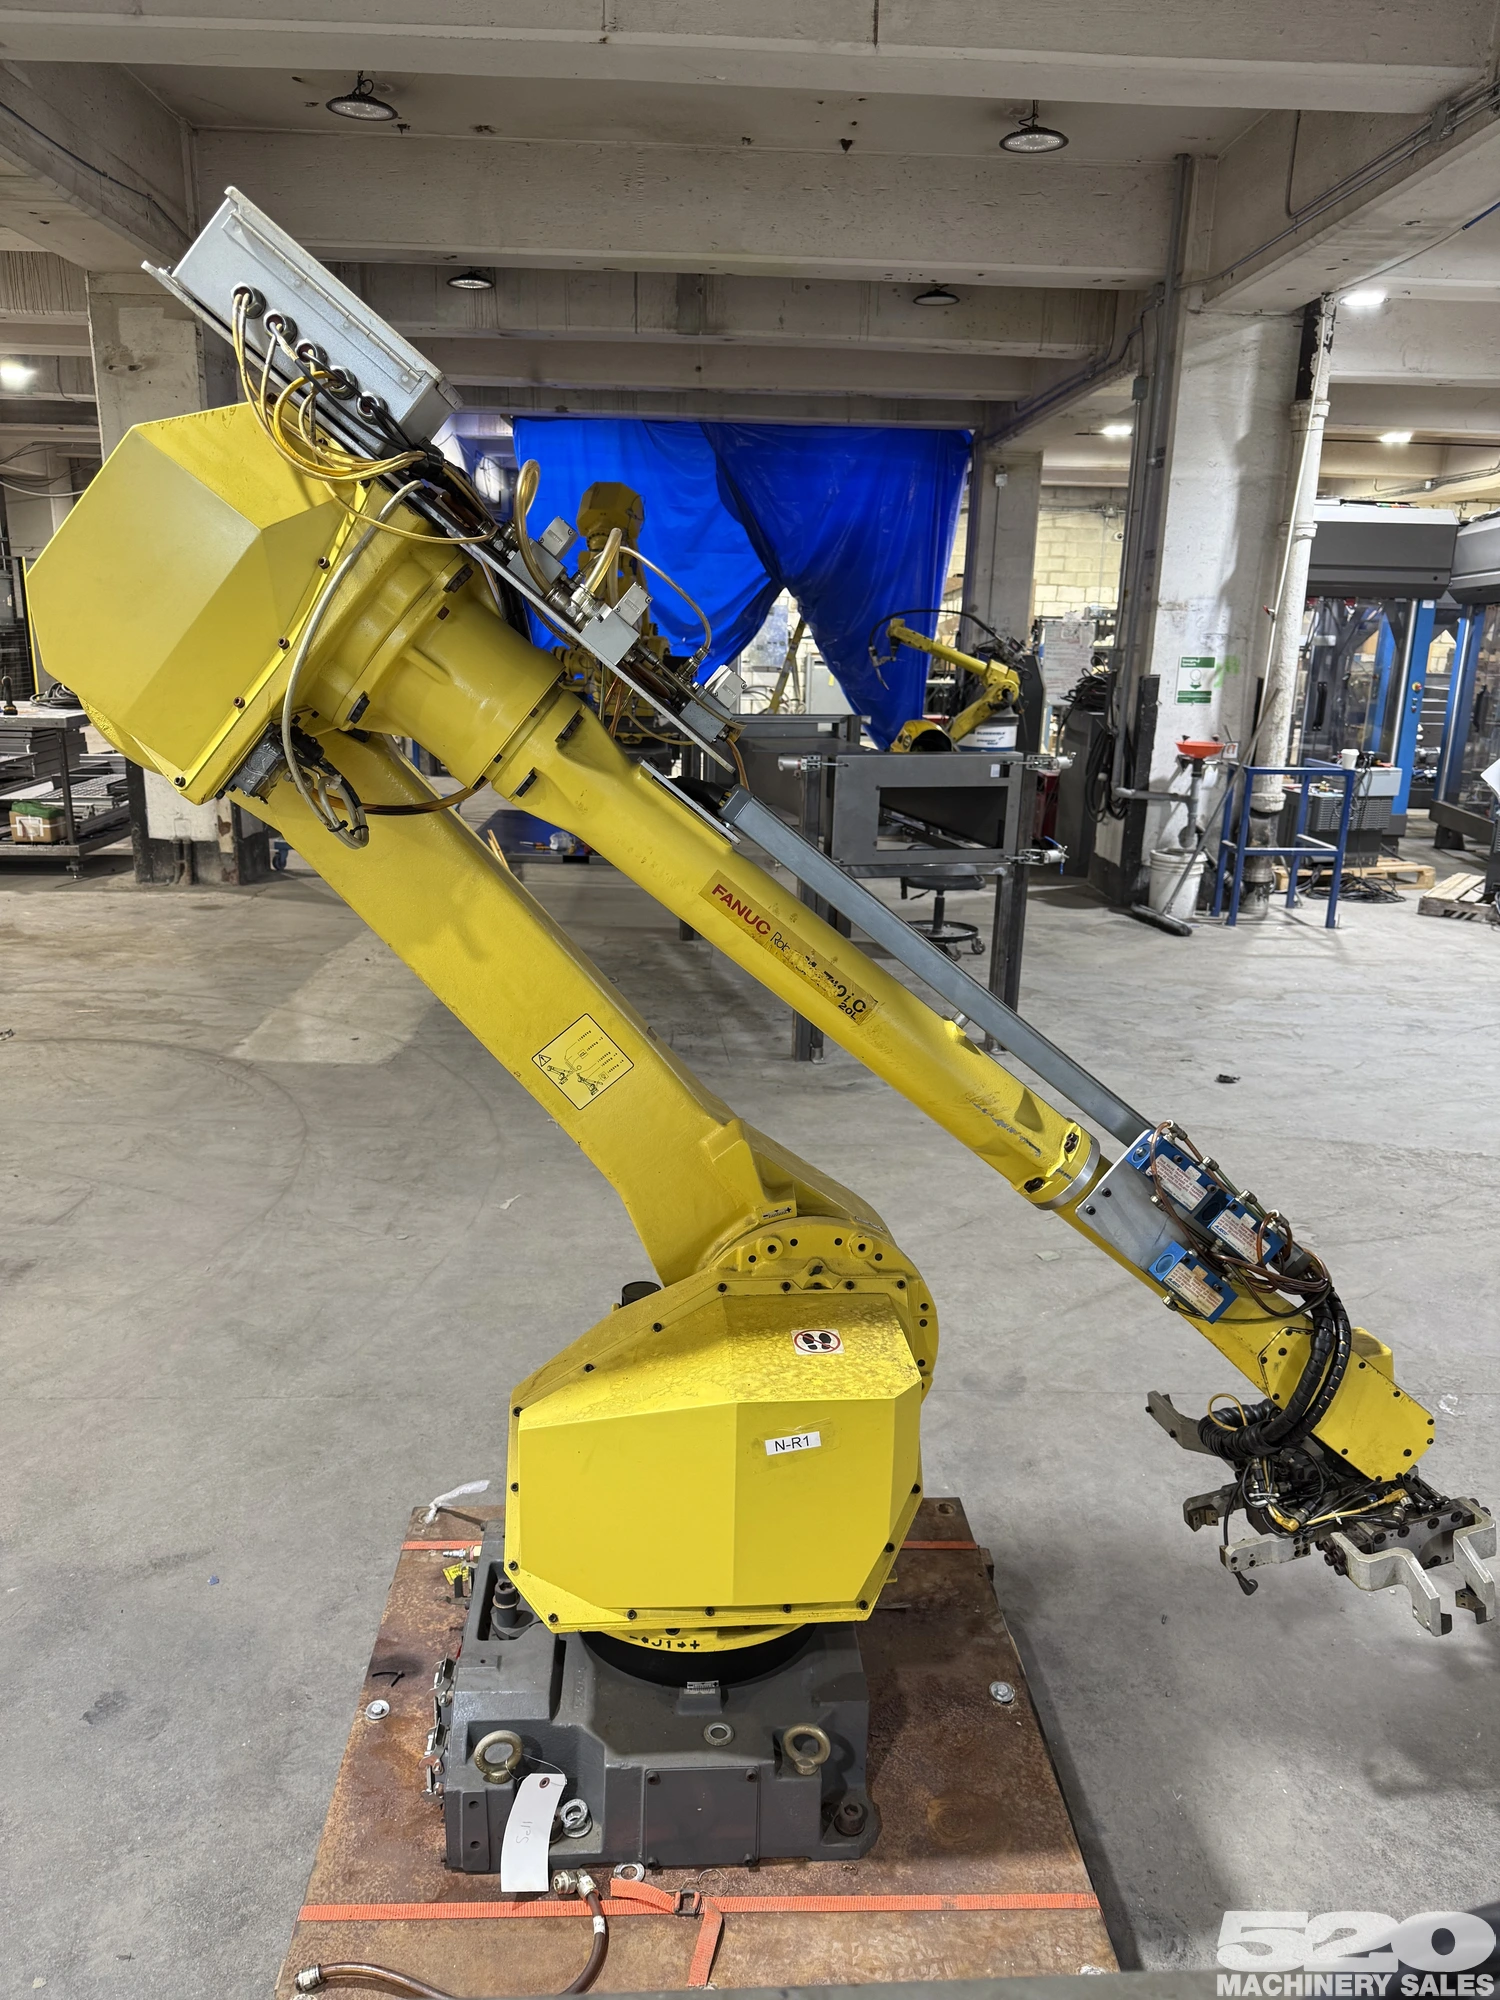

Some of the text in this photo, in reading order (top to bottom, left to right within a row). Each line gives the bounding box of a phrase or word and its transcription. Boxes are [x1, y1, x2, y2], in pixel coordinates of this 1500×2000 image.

[711, 883, 771, 936] FANUC
[838, 1002, 857, 1021] 20L
[774, 1435, 810, 1452] N-R1
